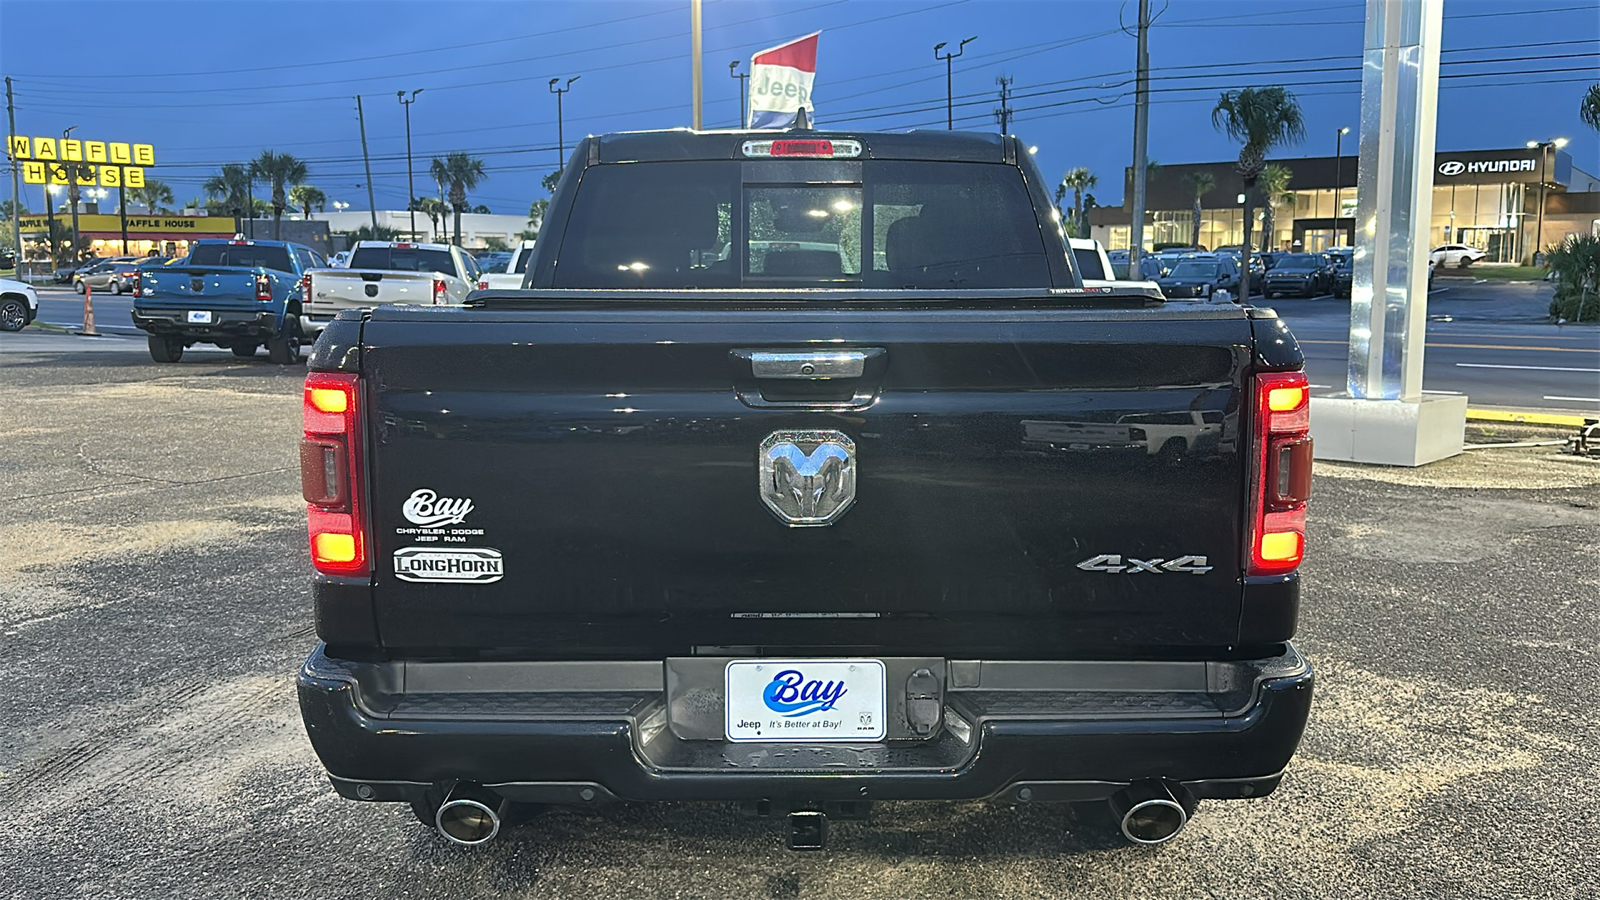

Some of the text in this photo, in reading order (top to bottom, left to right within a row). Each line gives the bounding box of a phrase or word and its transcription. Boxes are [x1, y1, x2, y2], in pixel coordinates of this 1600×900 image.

[757, 76, 808, 105] Jeep
[14, 139, 151, 162] WAFFLE
[1467, 159, 1536, 173] HYUNDAI
[164, 220, 196, 228] HOUSE
[403, 488, 475, 525] Bay
[764, 669, 848, 714] Bay
[736, 719, 843, 731] Jeep It's Better at Bay!
